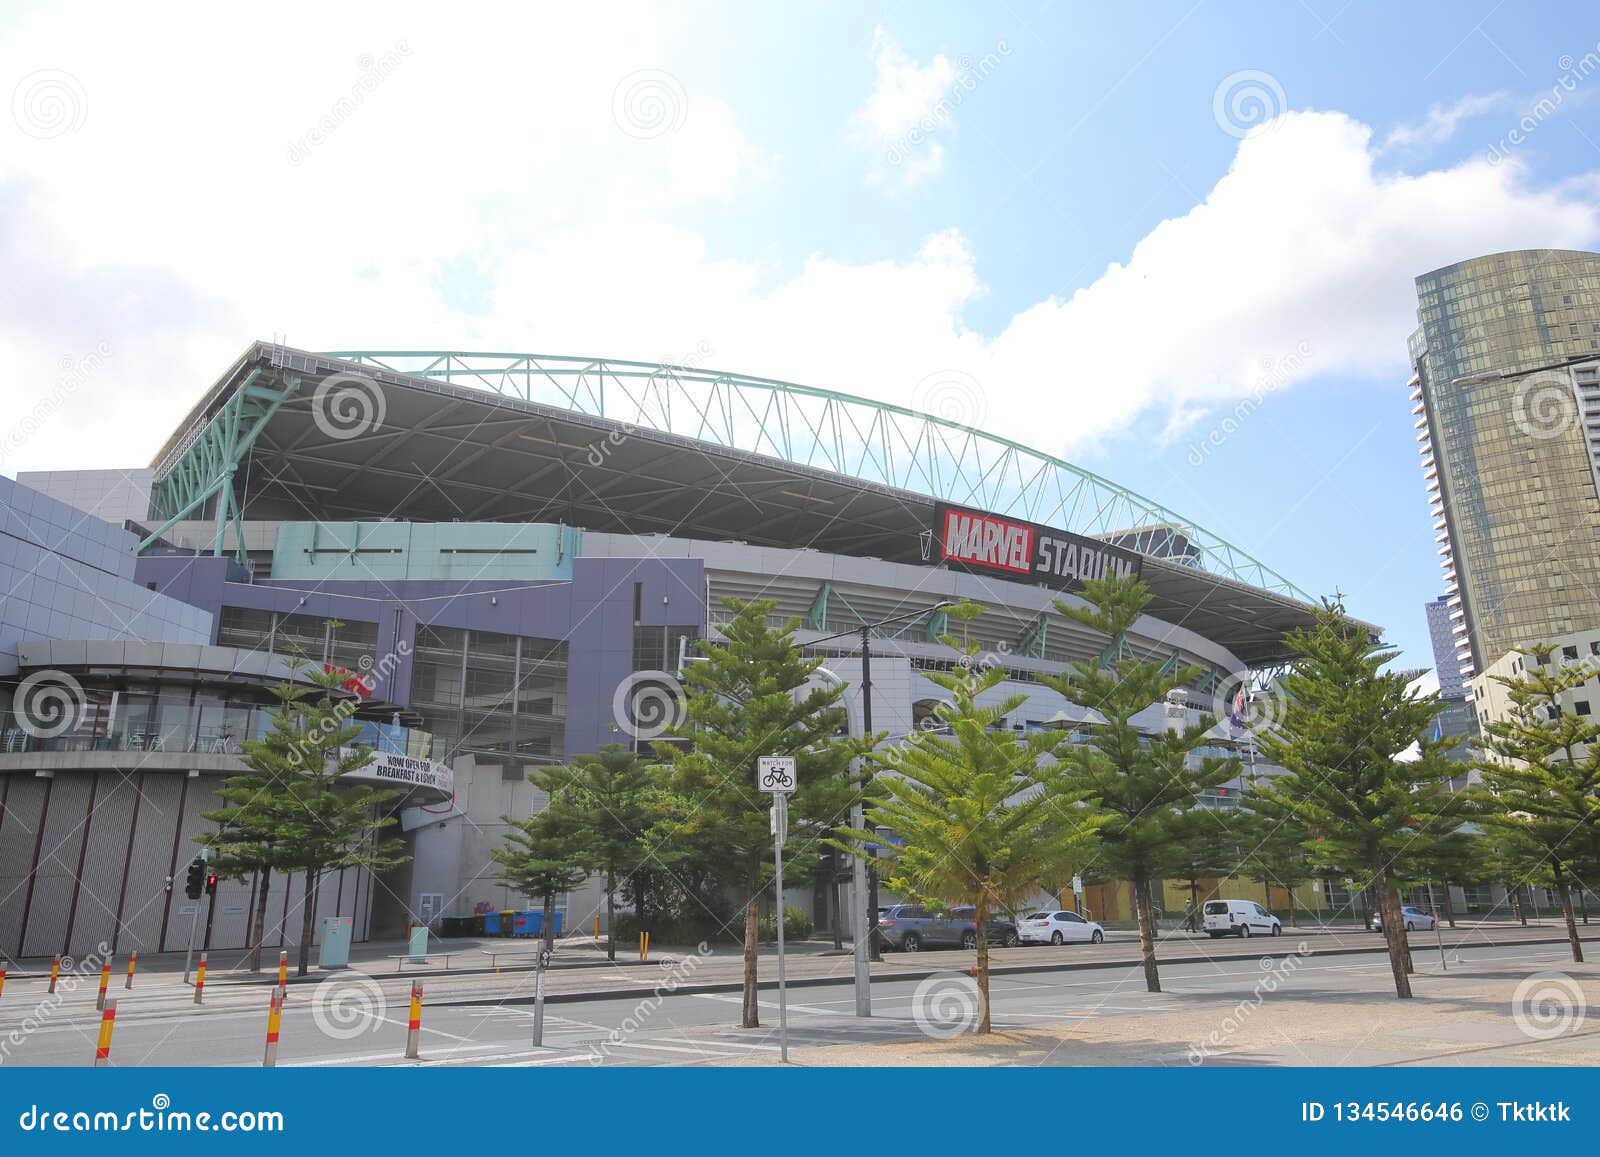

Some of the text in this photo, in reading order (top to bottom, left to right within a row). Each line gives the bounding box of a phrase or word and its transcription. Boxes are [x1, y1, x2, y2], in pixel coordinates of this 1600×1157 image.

[947, 514, 1132, 581] MARVEL STADIUM
[387, 757, 431, 773] NOW OPEN FOR
[376, 766, 414, 782] BREAKFAST
